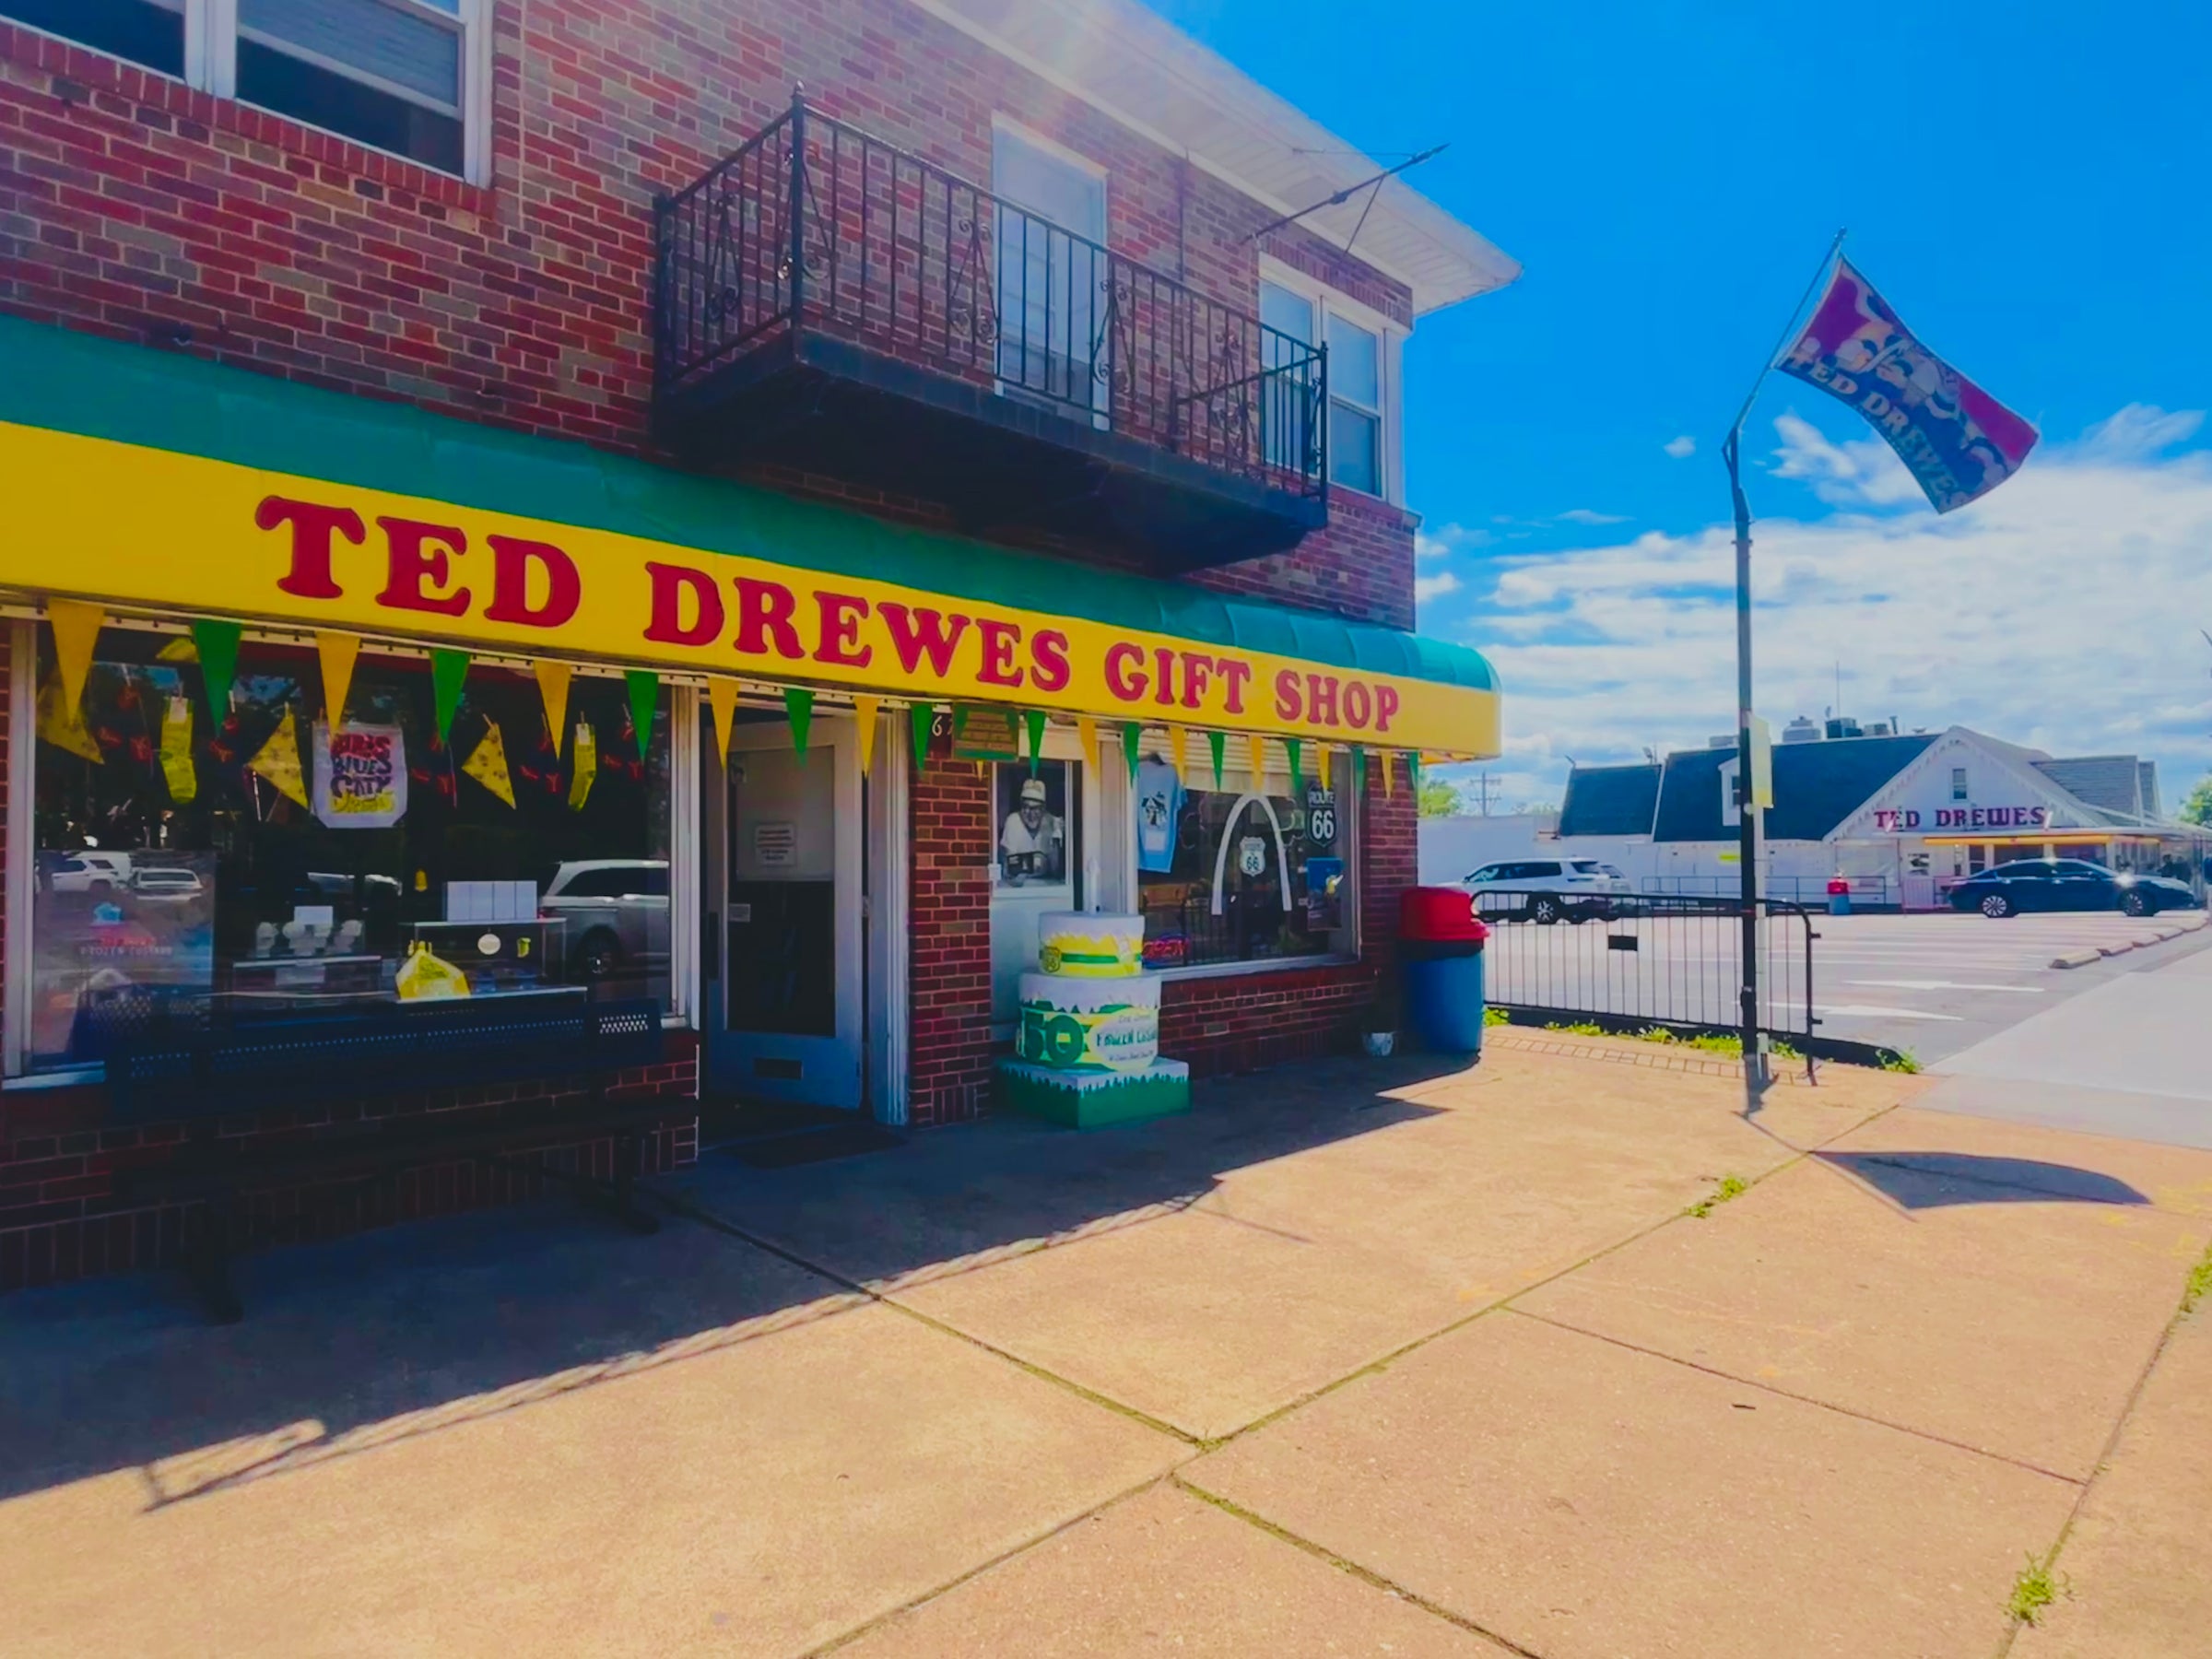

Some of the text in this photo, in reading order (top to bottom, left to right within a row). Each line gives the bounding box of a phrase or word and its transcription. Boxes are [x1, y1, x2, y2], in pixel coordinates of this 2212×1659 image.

[1787, 350, 1858, 394] TED
[255, 495, 1398, 731] TED DREWES GIFT SHOP
[1308, 791, 1335, 805] ROUTE
[1312, 809, 1335, 840] 66
[1874, 806, 2045, 829] TED DREWES
[1246, 855, 1260, 870] 66
